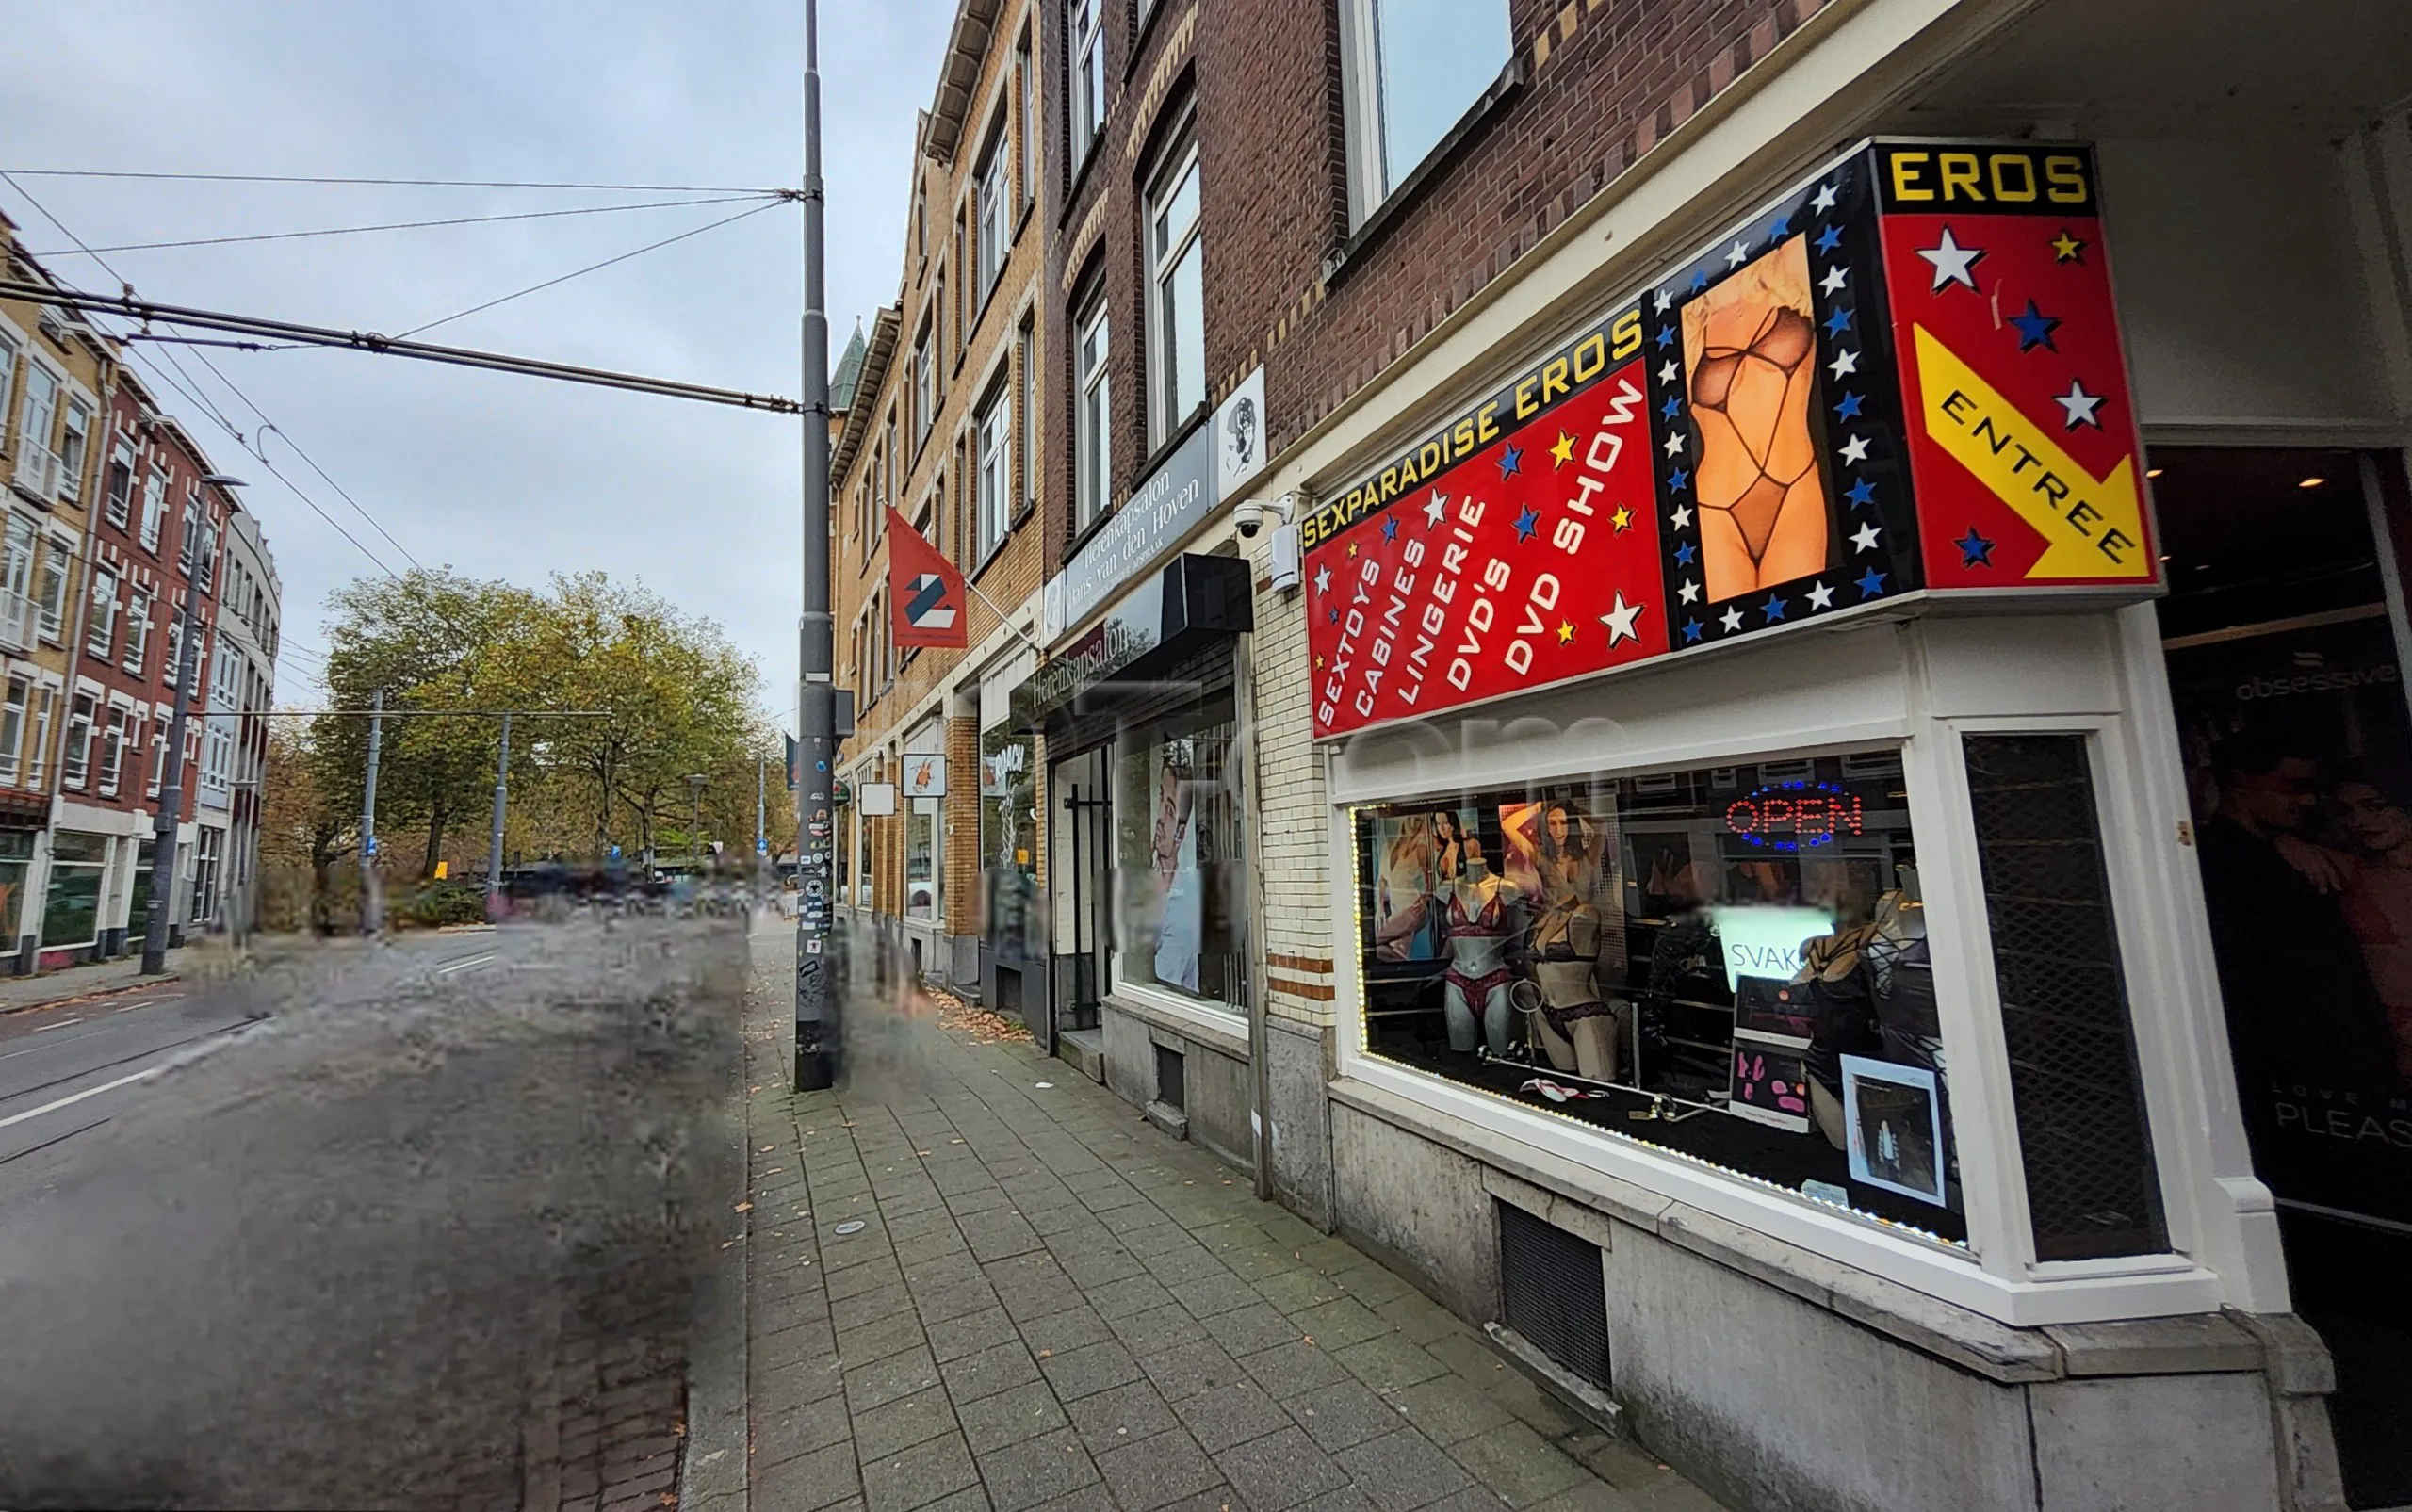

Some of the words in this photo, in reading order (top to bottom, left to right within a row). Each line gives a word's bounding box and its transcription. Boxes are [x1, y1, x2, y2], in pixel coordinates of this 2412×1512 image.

[1890, 152, 2087, 203] EROS
[1304, 400, 1500, 549] SEXPARADISE
[1516, 308, 1643, 421] EROS
[1940, 388, 2137, 565] ENTREE
[1084, 470, 1170, 569] Herenkapsalon
[1096, 552, 1117, 583] van
[1122, 526, 1147, 561] den
[1152, 477, 1199, 536] Hoven
[1505, 572, 1561, 676] DVD
[1553, 377, 1645, 556] SHOW
[1318, 557, 1380, 728] SEXTOYS
[1355, 538, 1426, 718] CABINES
[1397, 494, 1486, 706] LINGERIE
[1446, 557, 1512, 692] DVD'S
[1033, 618, 1129, 708] Herenkapsalon
[2236, 663, 2398, 701] obsessive
[995, 743, 1025, 781] ROACH
[1725, 795, 1863, 836] OPEN
